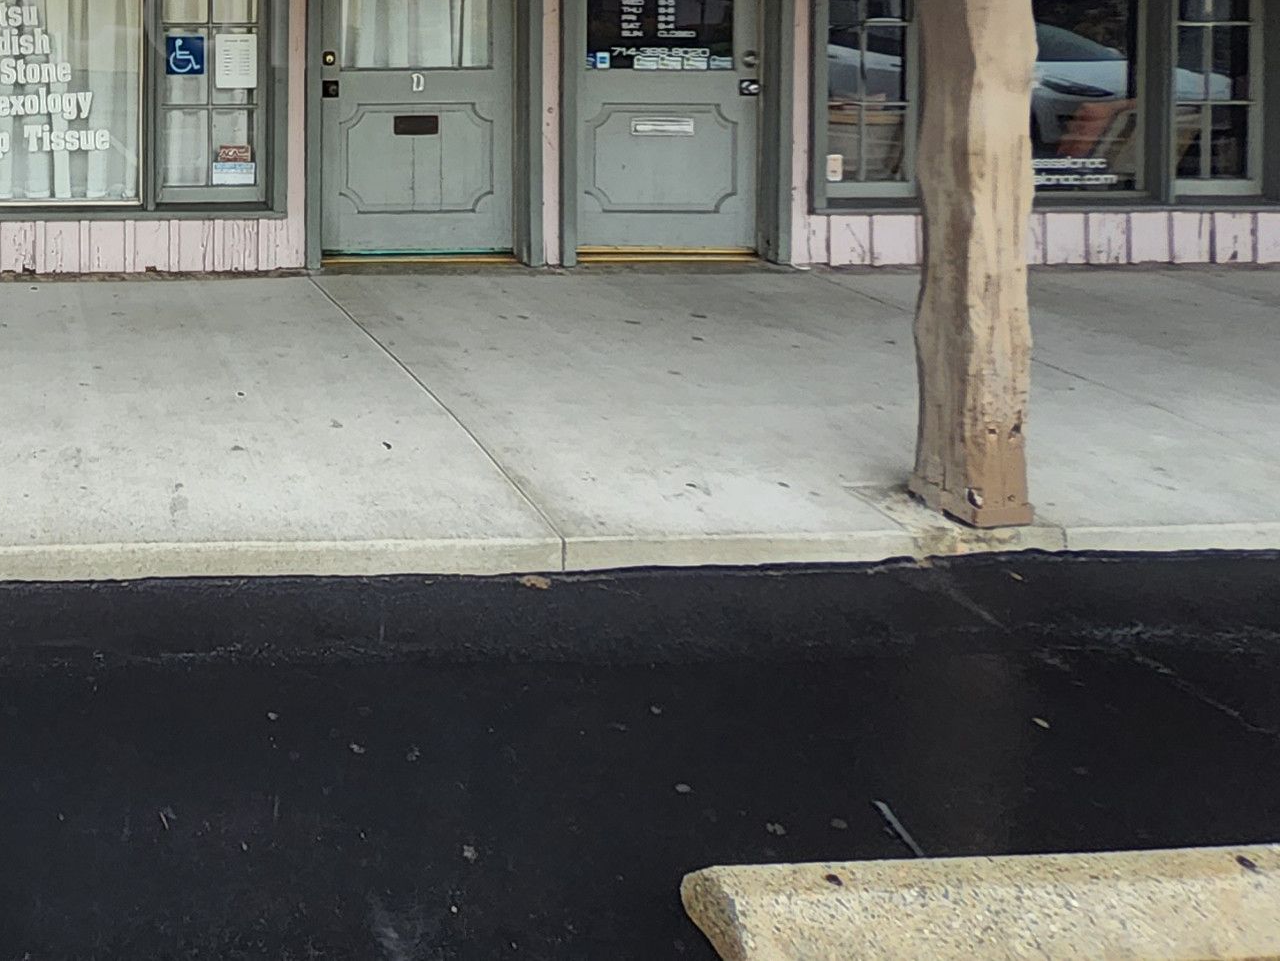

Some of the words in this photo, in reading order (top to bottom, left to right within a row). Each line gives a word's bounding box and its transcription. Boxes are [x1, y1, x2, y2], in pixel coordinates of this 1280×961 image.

[0, 58, 72, 85] Stone
[412, 73, 425, 92] D
[24, 125, 111, 153] Tissue
